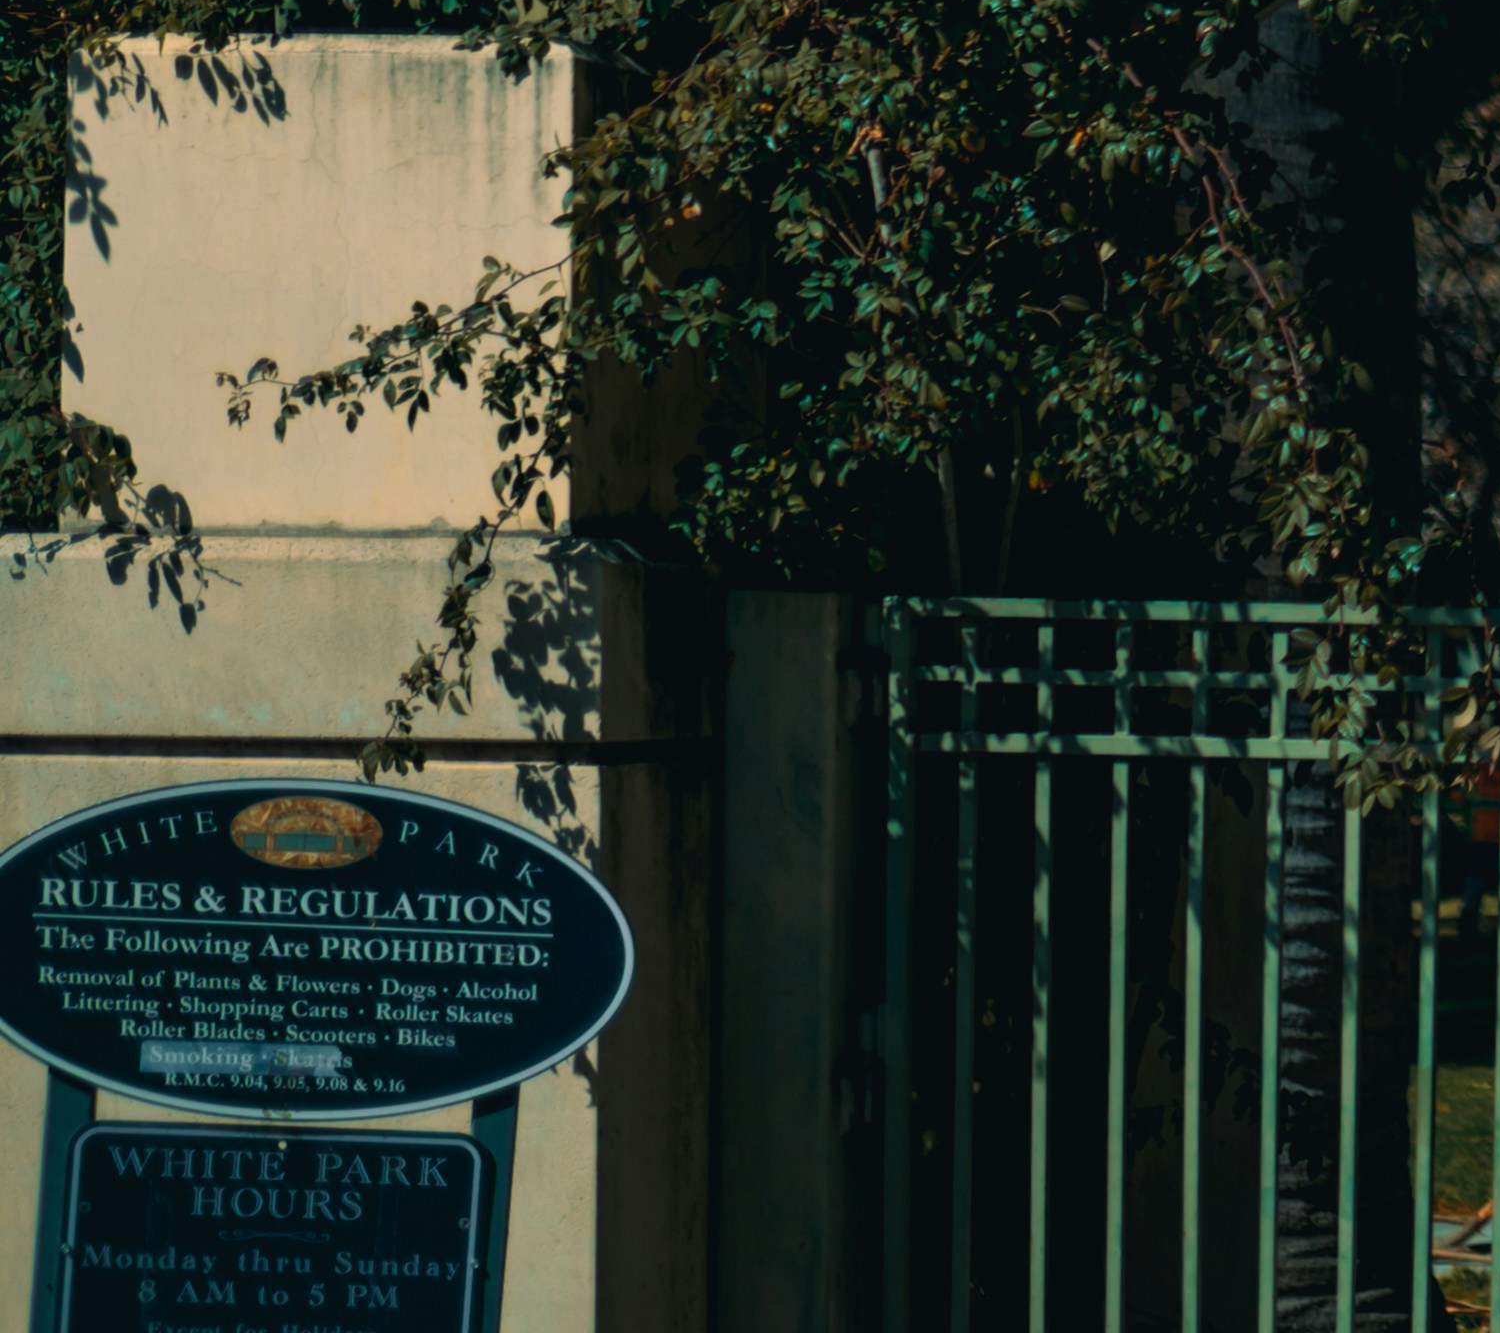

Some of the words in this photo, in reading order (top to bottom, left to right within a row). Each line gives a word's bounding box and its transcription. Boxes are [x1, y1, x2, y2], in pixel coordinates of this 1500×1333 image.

[58, 811, 217, 870] WHITE
[399, 821, 543, 888] PARK
[39, 878, 182, 910] RULES
[194, 885, 226, 913] &
[240, 885, 551, 926] REGULATIONS
[36, 925, 95, 949] The
[104, 928, 251, 963] Following
[259, 934, 309, 958] Are
[320, 936, 549, 967] PROHIBITED:
[38, 966, 134, 986] Removal
[141, 970, 165, 987] of
[174, 971, 240, 990] Plants
[248, 974, 268, 991] &
[276, 974, 360, 994] Flowers
[380, 978, 437, 1001] Dogs
[456, 981, 538, 1001] Alcohol
[62, 992, 160, 1018] Littering
[180, 996, 284, 1021] Shopping
[291, 1000, 348, 1019] Carts
[376, 1002, 440, 1022] Roller
[446, 1005, 513, 1025] Skates
[120, 1019, 186, 1038] Roller
[193, 1021, 266, 1041] Blades
[286, 1024, 376, 1044] Scooters
[397, 1028, 455, 1047] Bikes
[150, 1046, 254, 1071] Smoking
[164, 1072, 225, 1088] R.M.C.
[230, 1074, 267, 1091] 9.04,
[274, 1076, 310, 1092] 9.05,
[316, 1077, 348, 1091] 9.08
[353, 1078, 368, 1092] &
[374, 1079, 405, 1093] 9.16
[108, 1146, 286, 1180] WHITE
[315, 1153, 448, 1187] PARK
[190, 1186, 363, 1221] HOURS
[80, 1244, 217, 1274] Monday
[238, 1249, 311, 1274] thru
[334, 1251, 460, 1281] Sunday
[138, 1279, 156, 1303] 8
[175, 1281, 237, 1304] AM
[258, 1286, 288, 1306] to
[308, 1283, 326, 1307] 5
[346, 1284, 399, 1309] PM
